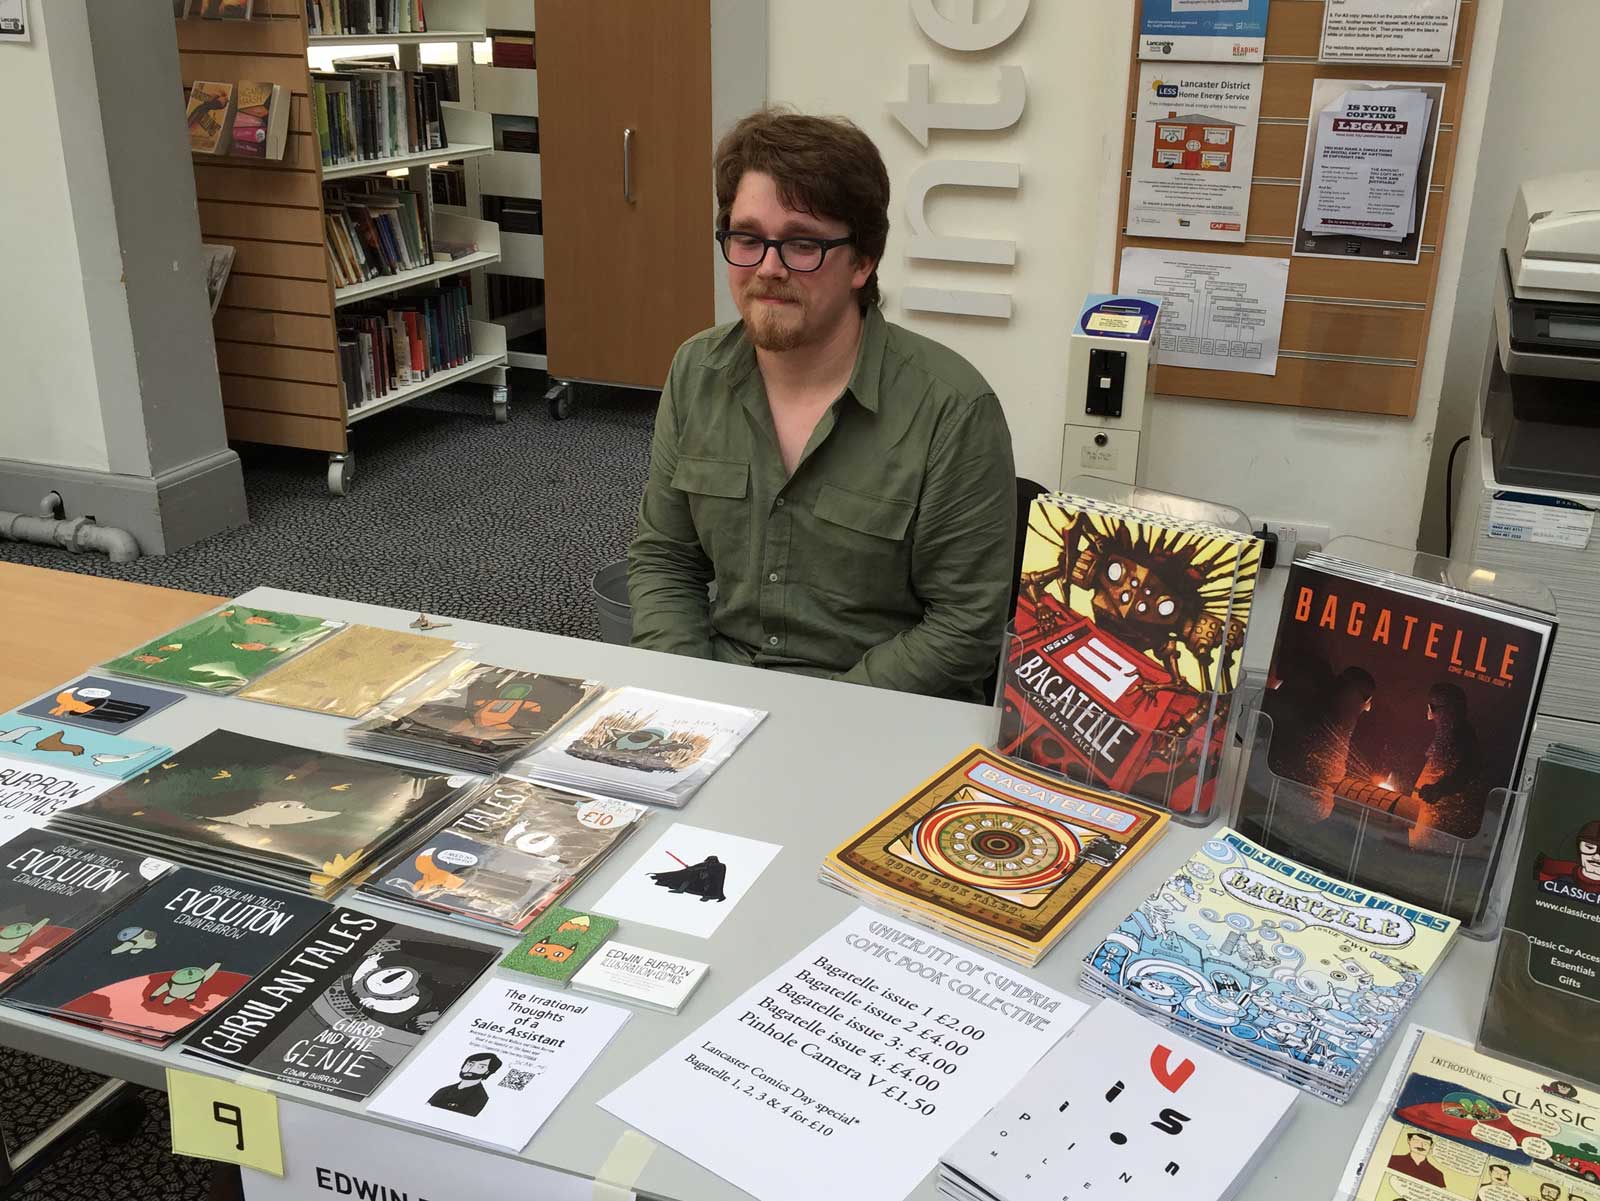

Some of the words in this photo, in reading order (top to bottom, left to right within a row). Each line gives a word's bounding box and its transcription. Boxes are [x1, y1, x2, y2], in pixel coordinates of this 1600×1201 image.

[1158, 87, 1177, 95] LESS
[1180, 80, 1218, 89] Lancaster
[1221, 81, 1250, 90] District
[1200, 92, 1223, 100] Energy
[1337, 121, 1404, 132] LEGAL?
[1346, 111, 1396, 119] COPYING
[1042, 633, 1076, 654] ISSUE
[1295, 586, 1519, 681] BAGATELLE
[1015, 655, 1135, 764] BAGATELLE
[1071, 731, 1095, 756] TALES
[452, 788, 526, 833] TALES
[982, 766, 1127, 827] BAGATELLE
[581, 811, 614, 826] £10
[6, 848, 130, 893] EVOLUTION
[53, 845, 97, 863] GHRULAN
[95, 855, 124, 869] TALES
[13, 873, 45, 890] EDWIN
[38, 878, 82, 896] BURROW
[1224, 834, 1295, 877] COMIC
[1296, 871, 1366, 903] BOOK
[1367, 897, 1451, 933] TALES
[164, 887, 295, 936] EVOLUTION
[209, 885, 256, 904] GHRULAN
[254, 896, 285, 911] TALES
[1228, 871, 1402, 940] BAGATELLE
[174, 913, 205, 929] EDWIN
[202, 920, 248, 940] BURROW
[1313, 926, 1340, 938] ISSUE
[1343, 939, 1368, 953] TWO
[1528, 935, 1557, 950] Classic
[1558, 943, 1574, 955] Car
[606, 949, 644, 964] EDWIN
[644, 958, 695, 977] BURROW
[868, 920, 957, 966] UNIVERSITY
[957, 959, 985, 978] OF
[983, 972, 1062, 1015] CUMBRIA
[1551, 957, 1596, 977] Essentials
[201, 969, 316, 1054] GHRULAN
[289, 912, 377, 969] TALES
[845, 933, 898, 969] COMIC
[897, 956, 949, 987] BOOK
[947, 979, 1053, 1033] COLLECTIVE
[1559, 975, 1581, 989] Gifts
[504, 988, 526, 1001] The
[528, 994, 589, 1015] Irrational
[508, 1001, 566, 1023] Thoughts
[812, 955, 878, 993] Bagatelle
[880, 984, 919, 1012] issue
[922, 1006, 934, 1019] 1
[936, 1012, 986, 1042] £2.00
[513, 1016, 532, 1026] of
[530, 1021, 540, 1029] a
[794, 968, 863, 1007] Bagatelle
[863, 997, 902, 1027] issue
[903, 1019, 918, 1034] 2
[917, 1026, 969, 1059] £4.00
[313, 1029, 344, 1045] AND
[343, 1035, 380, 1052] THE
[332, 1017, 385, 1039] GHROB
[471, 1017, 506, 1033] Sales
[505, 1026, 566, 1048] Assistant
[776, 982, 845, 1021] Bagatelle
[845, 1012, 885, 1043] issue
[885, 1032, 904, 1050] 3:
[904, 1044, 957, 1078] £4.00
[283, 1040, 375, 1078] GENIE
[757, 995, 827, 1037] Bagatelle
[827, 1026, 867, 1058] issue
[869, 1051, 887, 1069] 4:
[886, 1060, 940, 1095] £4.00
[282, 1068, 309, 1078] EDWIN
[308, 1072, 343, 1085] BURROW
[701, 1040, 750, 1073] Lancaster
[750, 1065, 792, 1093] Comics
[791, 1086, 815, 1107] Day
[738, 1010, 798, 1048] Pinhole
[800, 1042, 861, 1082] Camera
[866, 1073, 885, 1089] V
[881, 1083, 937, 1118] £1.50
[684, 1053, 731, 1086] Bagatelle
[731, 1078, 743, 1092] 1,
[742, 1084, 756, 1098] 2,
[756, 1090, 767, 1103] 3
[767, 1096, 781, 1110] &
[781, 1103, 791, 1116] 4
[790, 1105, 809, 1124] for
[808, 1117, 834, 1138] £10
[1502, 1089, 1596, 1132] CLASSIC
[213, 1100, 245, 1151] 9
[1019, 1112, 1031, 1123] P
[1119, 1172, 1132, 1184] N
[1083, 1182, 1092, 1190] E
